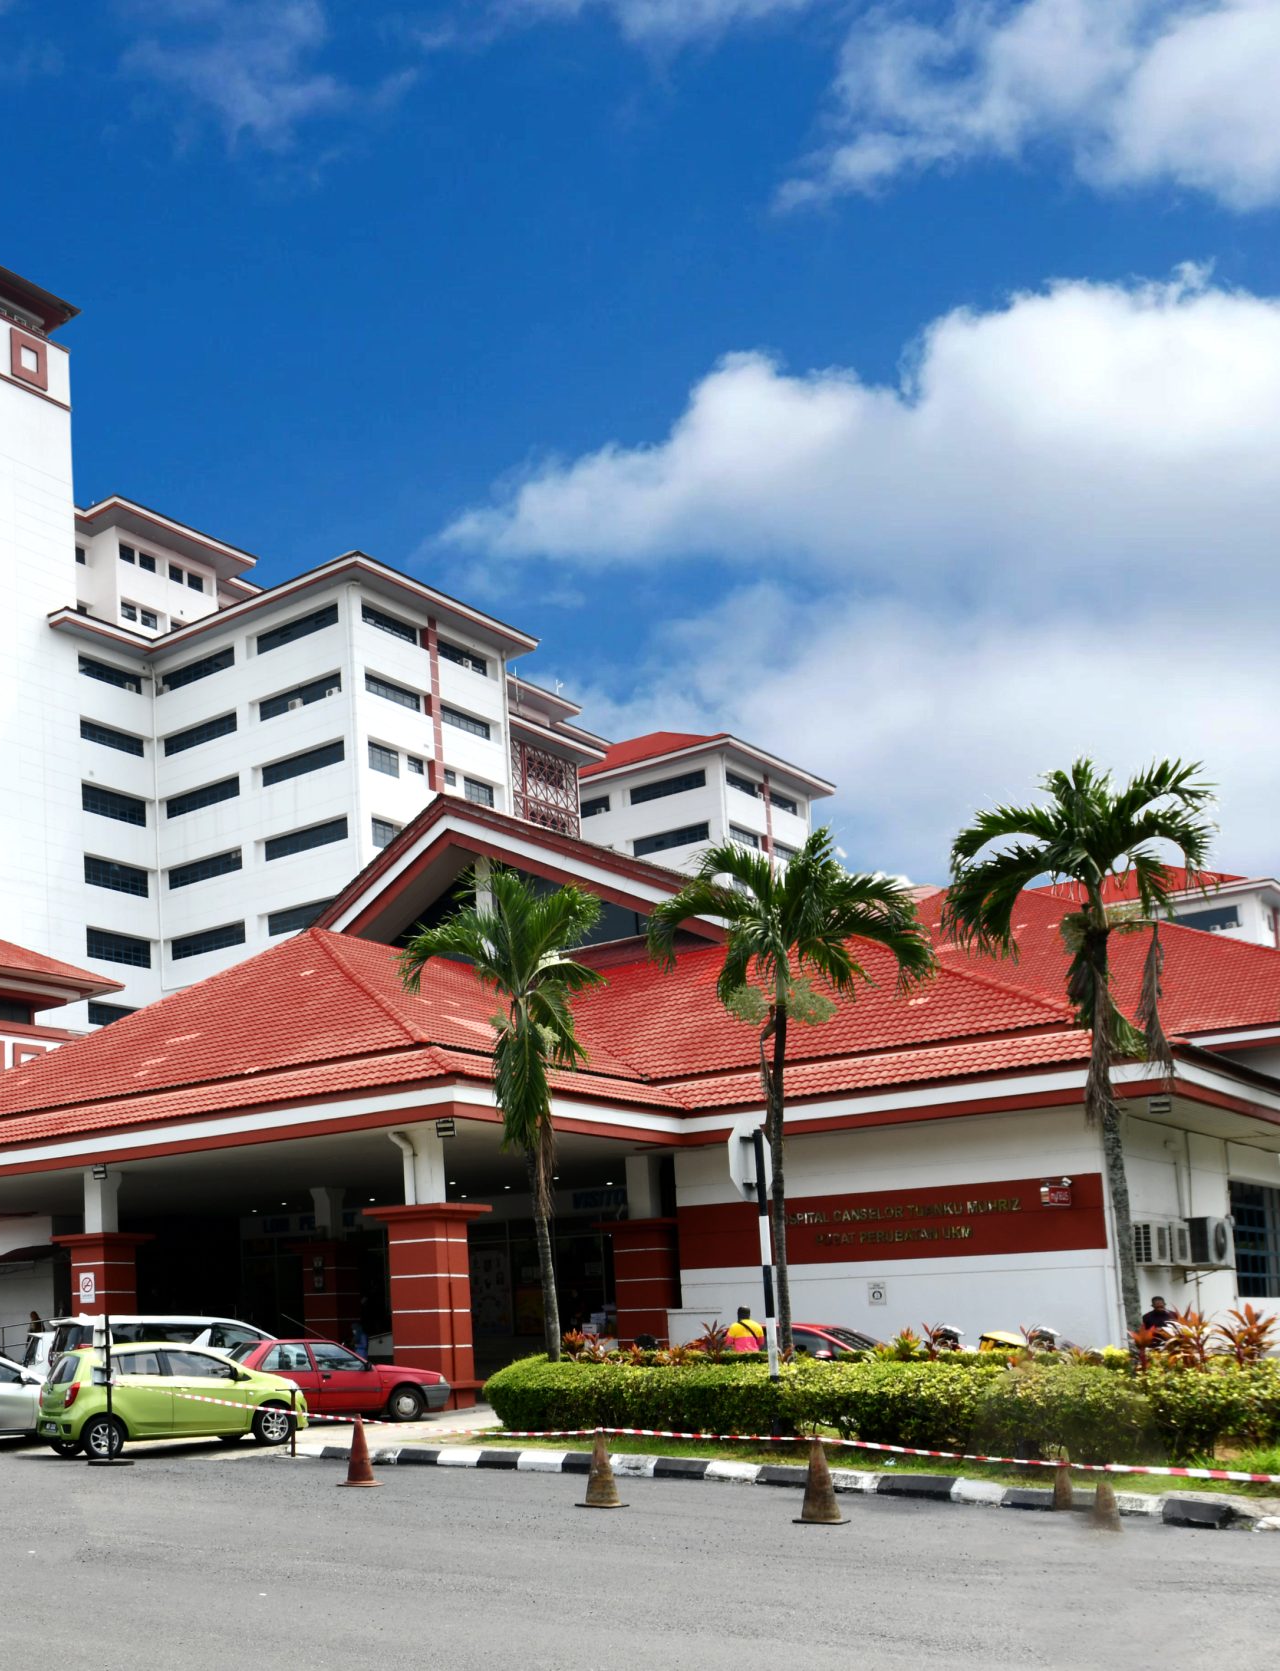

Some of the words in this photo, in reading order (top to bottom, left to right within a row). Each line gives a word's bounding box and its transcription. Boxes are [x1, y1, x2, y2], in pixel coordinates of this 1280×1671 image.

[771, 1211, 829, 1226] OSPITAL
[833, 1205, 904, 1222] CANSELOR
[966, 1198, 1022, 1214] MUHRIZ
[942, 1225, 972, 1239] UKM
